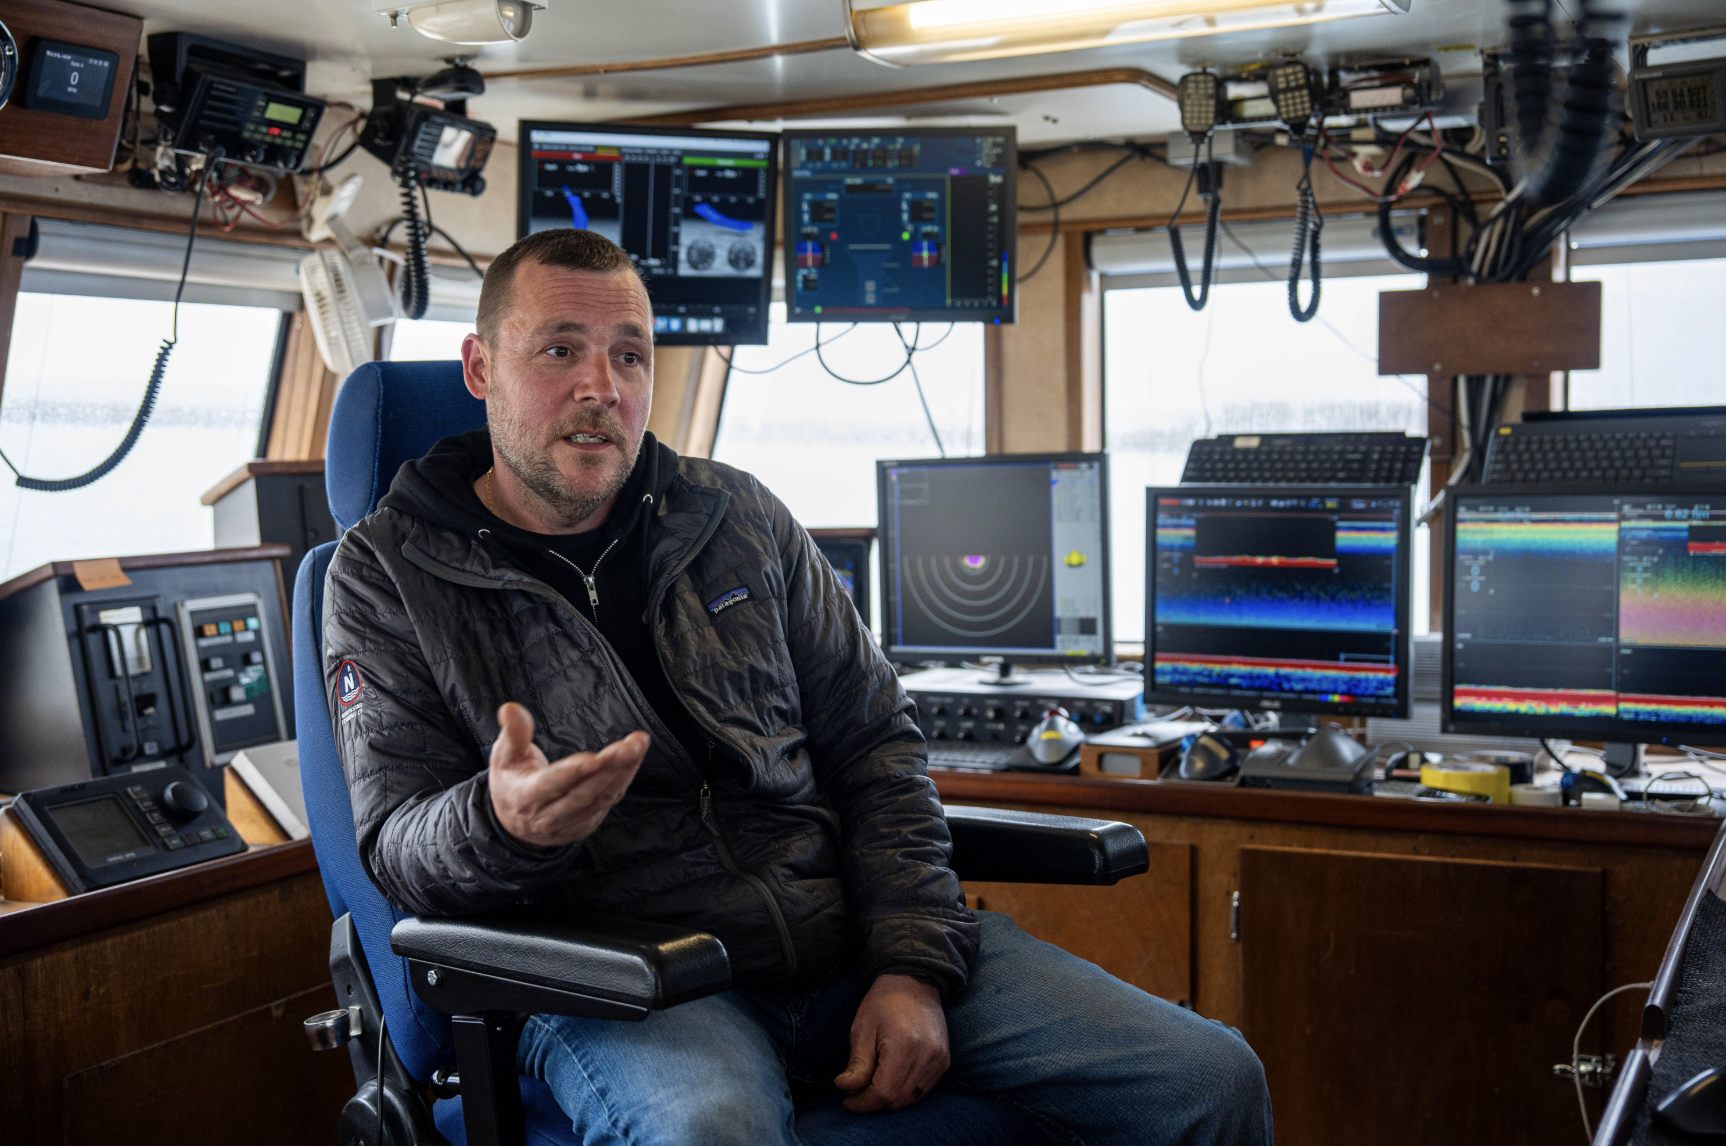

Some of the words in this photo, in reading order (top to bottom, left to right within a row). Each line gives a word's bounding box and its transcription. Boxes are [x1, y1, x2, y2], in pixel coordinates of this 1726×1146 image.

[70, 71, 79, 85] 0
[713, 593, 748, 613] patagonia
[344, 672, 354, 693] N
